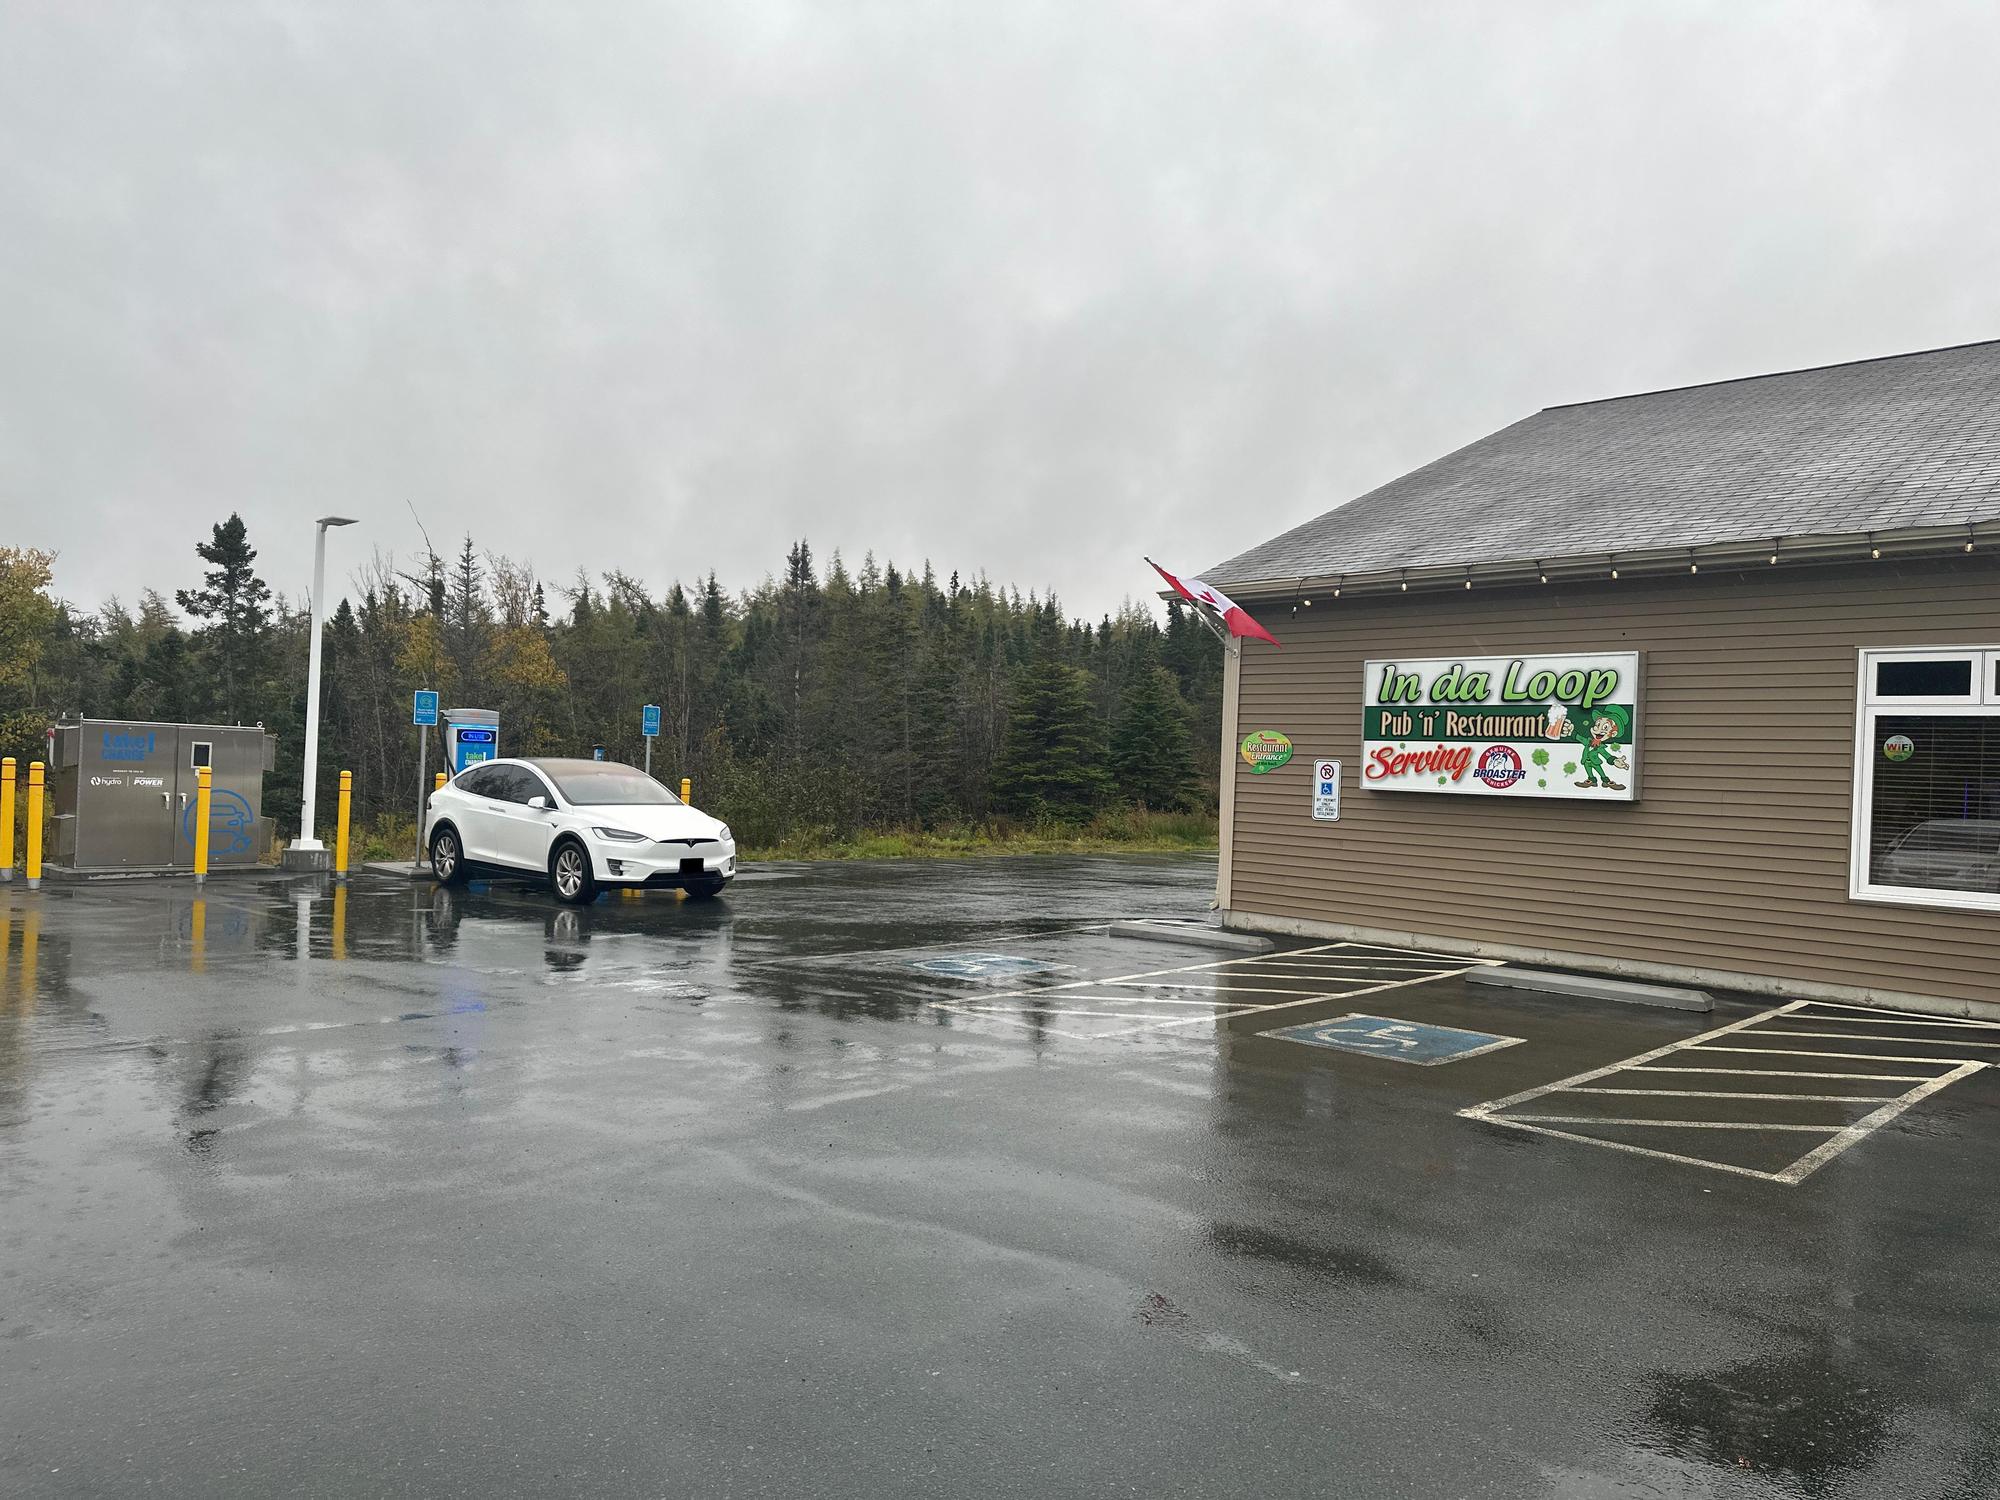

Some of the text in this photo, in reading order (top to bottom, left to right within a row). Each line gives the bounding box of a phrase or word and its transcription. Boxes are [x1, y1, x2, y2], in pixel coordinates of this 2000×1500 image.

[1378, 660, 1618, 709] In da Loop
[1380, 711, 1412, 737] Pub
[1446, 711, 1546, 738] Restaurant
[1247, 741, 1288, 752] Restaurant
[1485, 746, 1516, 757] GENUINE
[1251, 752, 1283, 761] Entrance
[1365, 743, 1474, 782] Serving
[1473, 769, 1526, 779] BROASTER
[101, 778, 122, 786] hydro
[1486, 778, 1513, 787] CHICKEN
